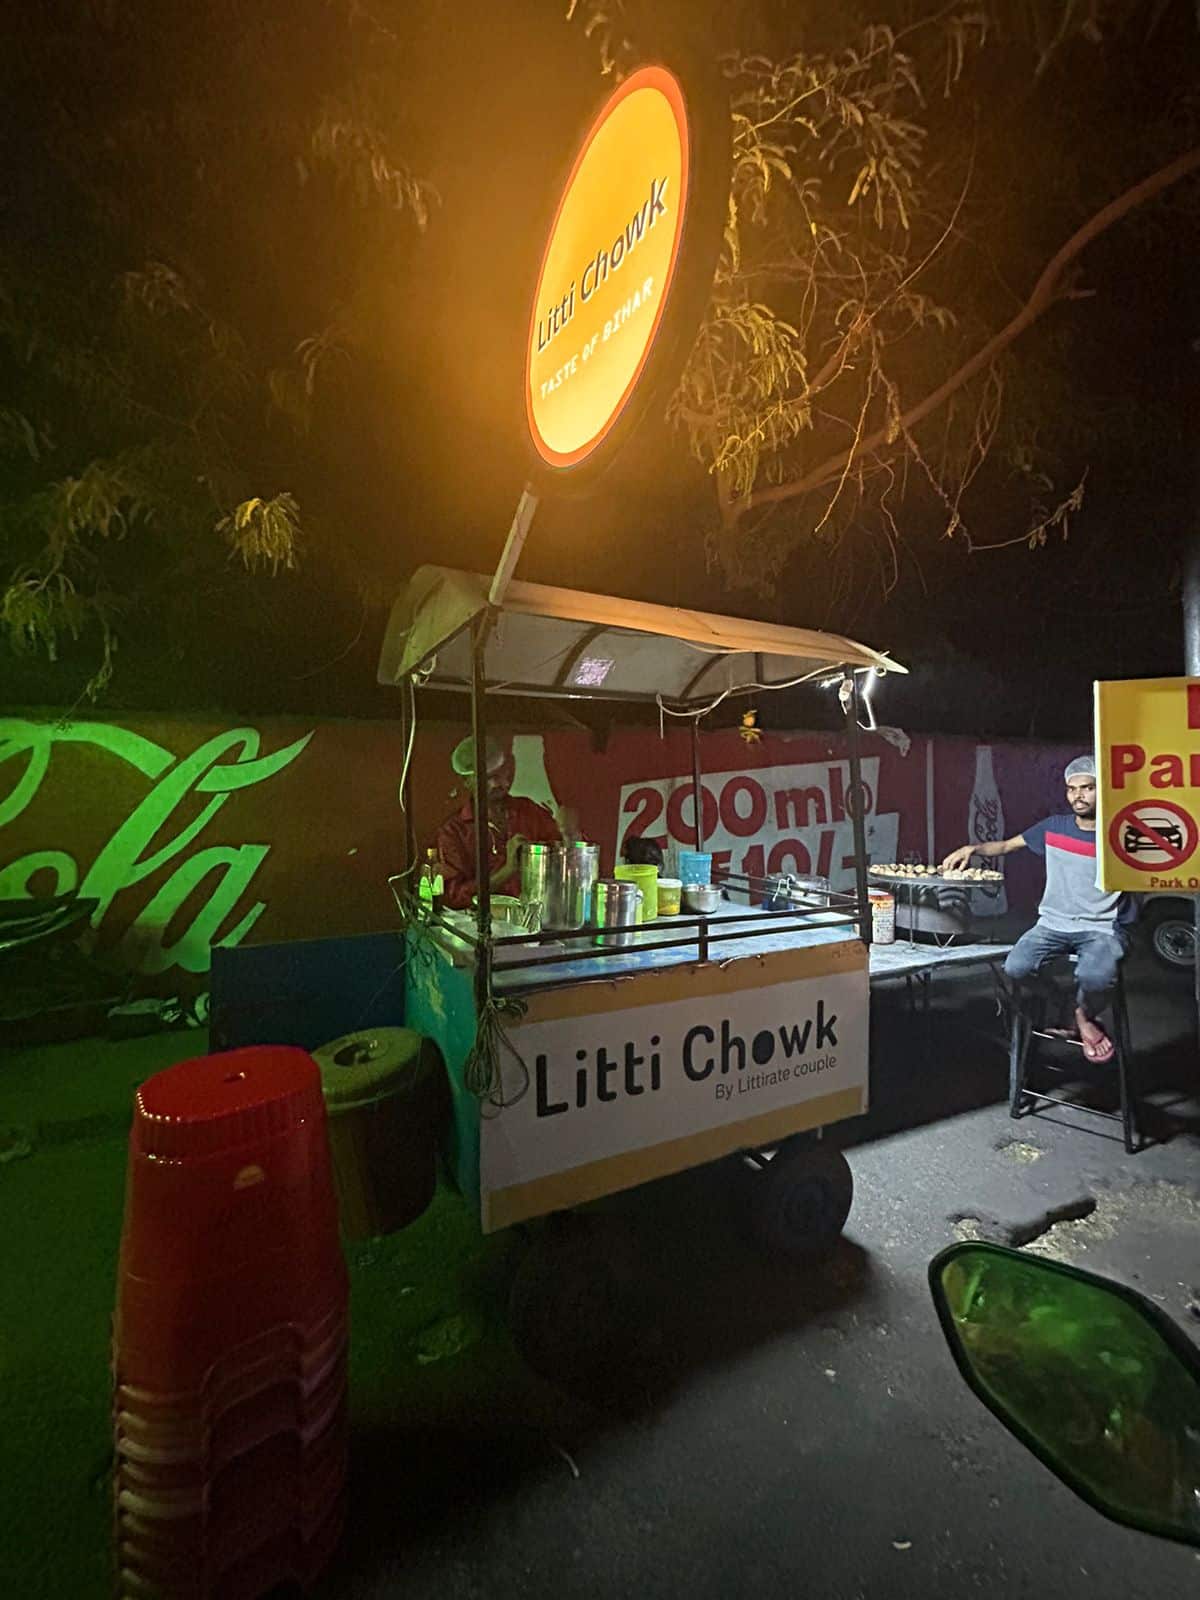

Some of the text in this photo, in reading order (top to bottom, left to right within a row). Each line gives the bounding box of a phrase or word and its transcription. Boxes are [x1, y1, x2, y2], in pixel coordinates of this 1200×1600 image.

[537, 281, 576, 352] Litti
[540, 275, 655, 400] TASTE OF BIHAR
[1150, 877, 1183, 888] Park
[535, 1000, 838, 1118] Litti Chowk
[715, 1053, 838, 1100] By Littirate couple
